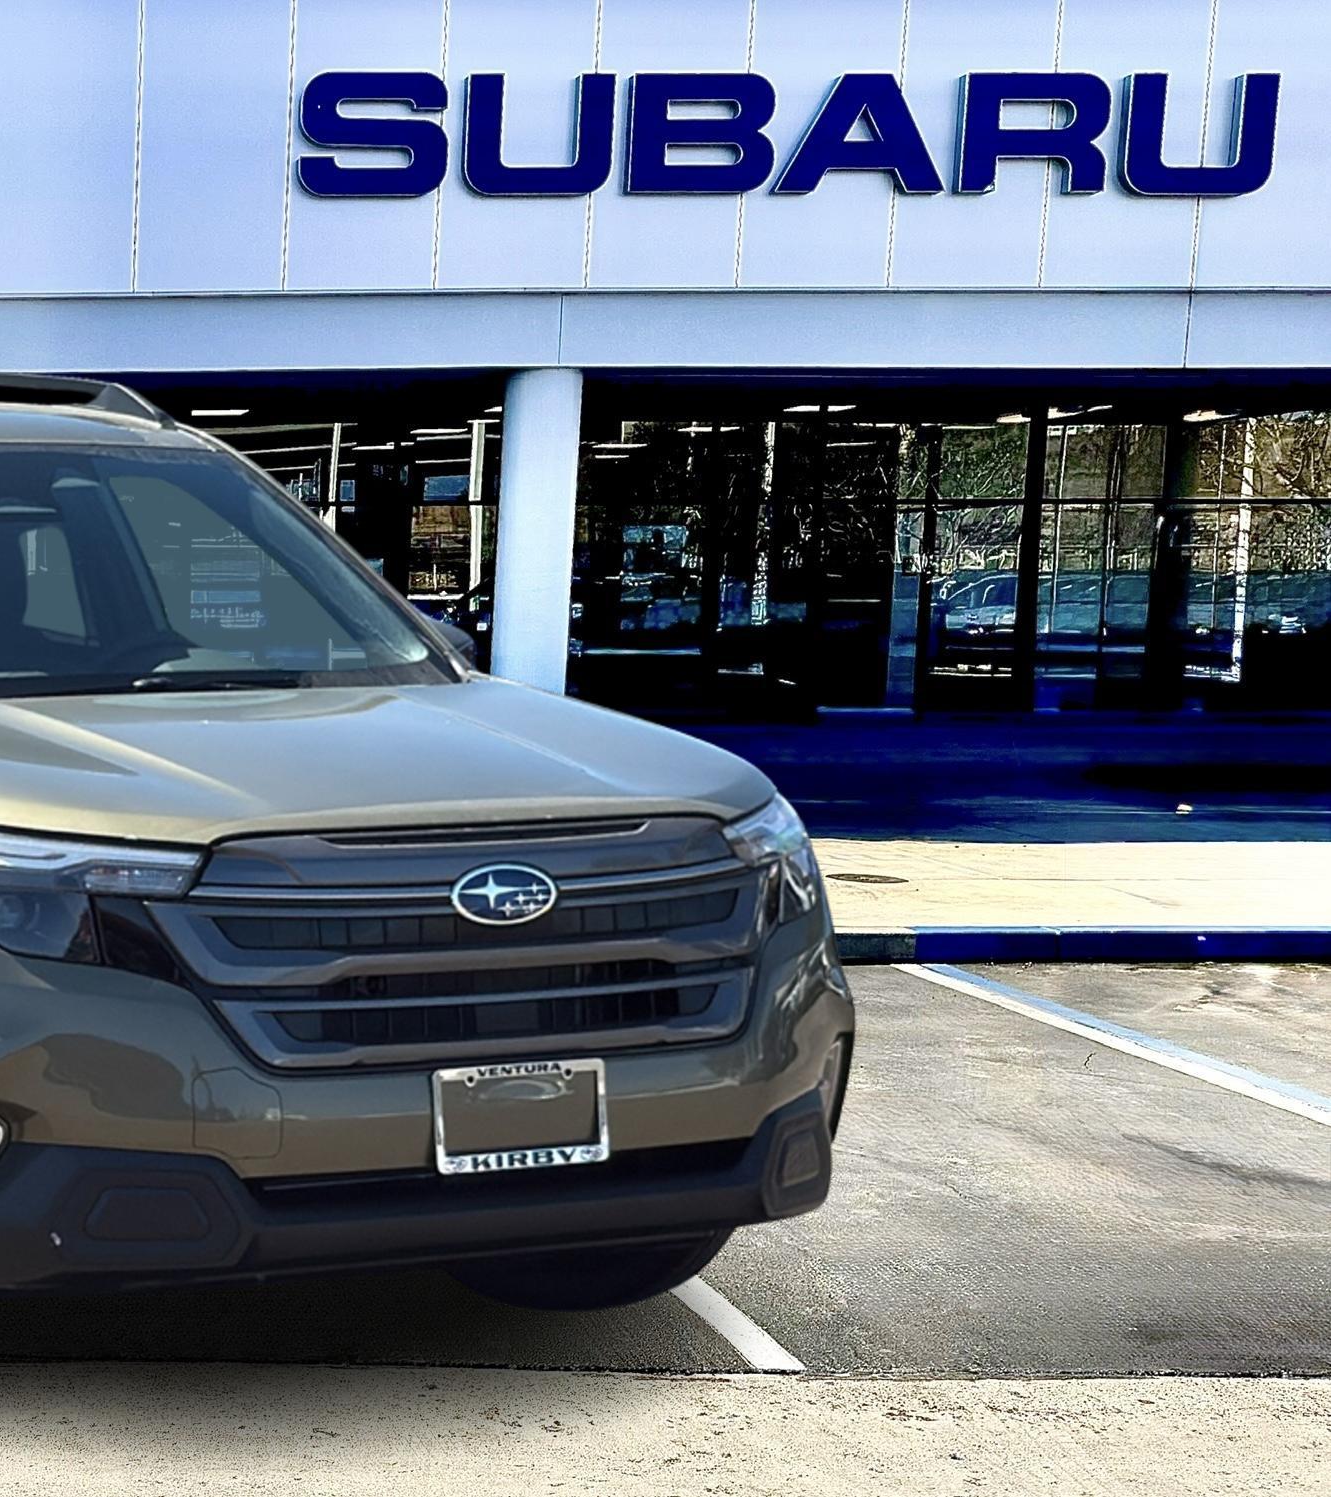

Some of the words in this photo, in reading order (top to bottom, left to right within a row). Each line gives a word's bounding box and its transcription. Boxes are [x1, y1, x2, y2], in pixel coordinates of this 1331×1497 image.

[297, 71, 1282, 197] SUBARU
[477, 1062, 562, 1077] VENTURA
[472, 1148, 576, 1171] KIRBY
